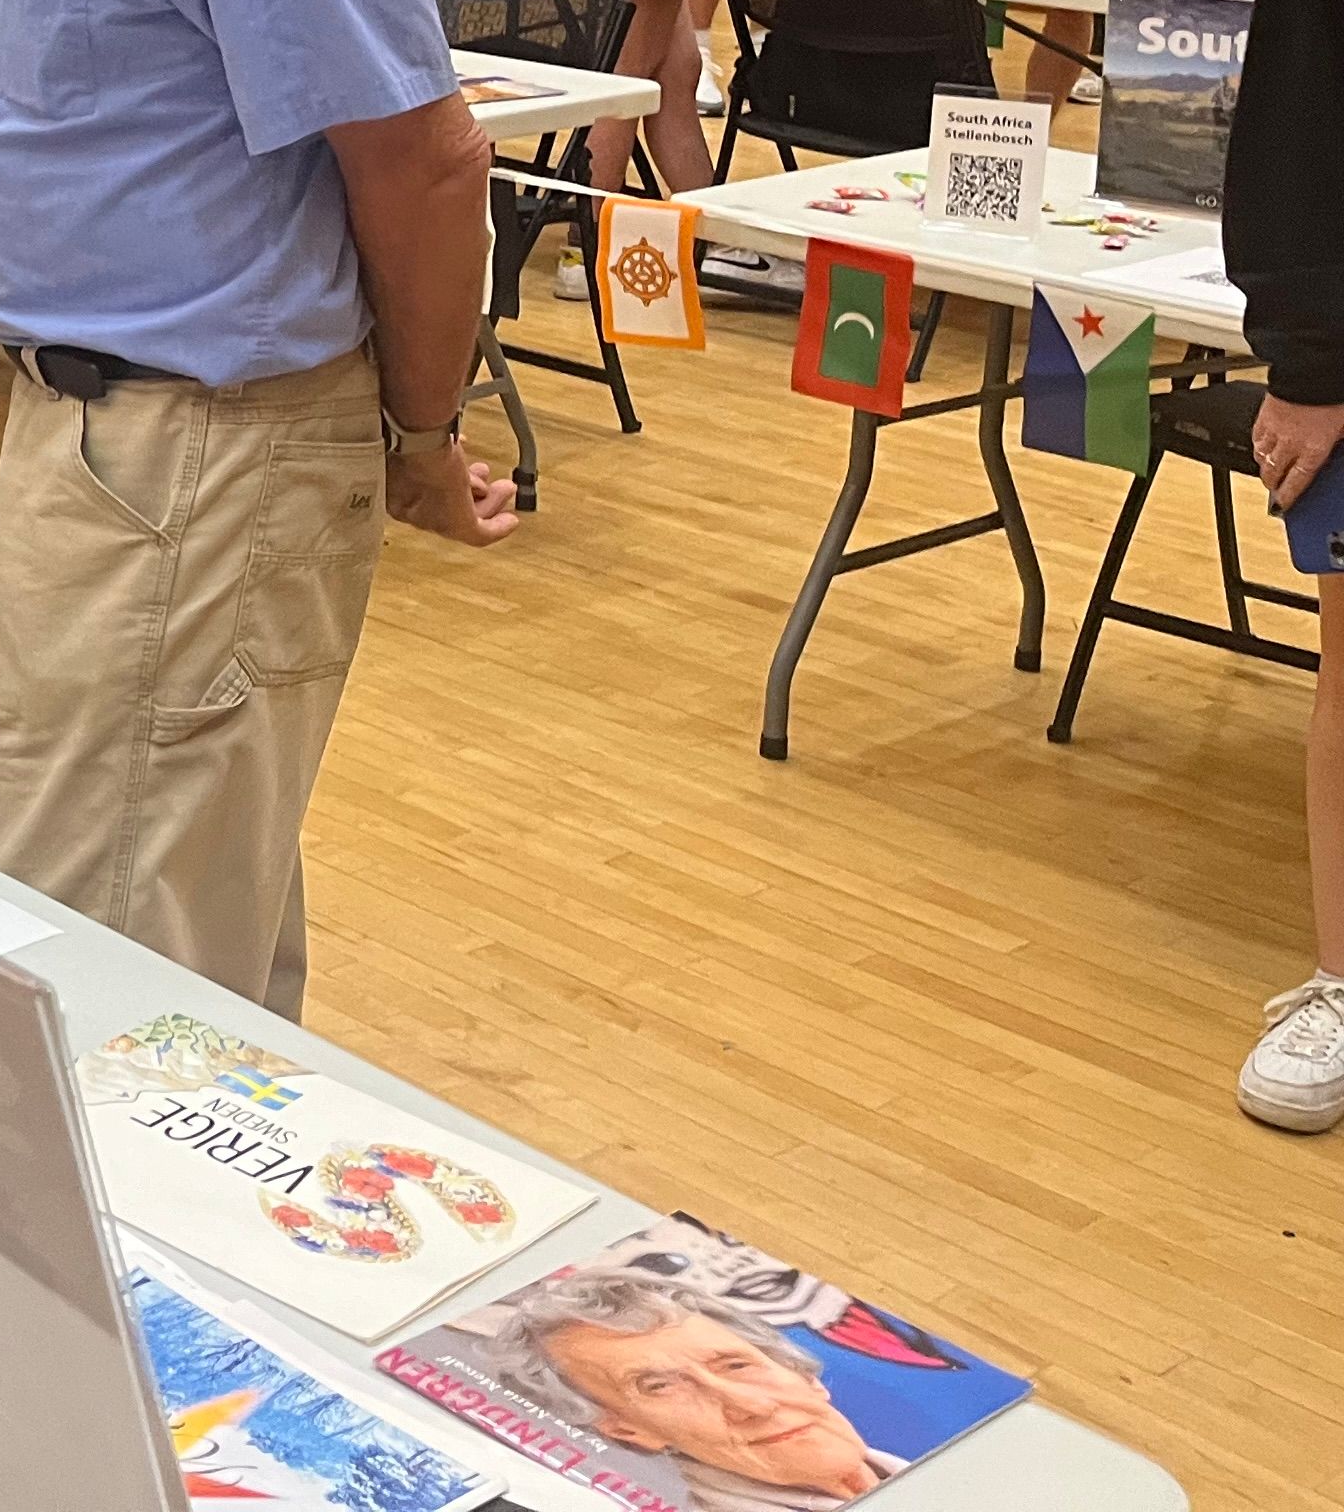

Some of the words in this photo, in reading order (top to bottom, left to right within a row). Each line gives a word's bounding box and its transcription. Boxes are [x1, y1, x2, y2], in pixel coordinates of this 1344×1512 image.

[947, 111, 989, 126] South
[991, 114, 1033, 130] Africa
[944, 127, 1033, 146] Stellenbosch
[204, 1097, 299, 1145] SWEDEN
[374, 1346, 588, 1476] LINDGREN
[585, 1437, 609, 1454] by
